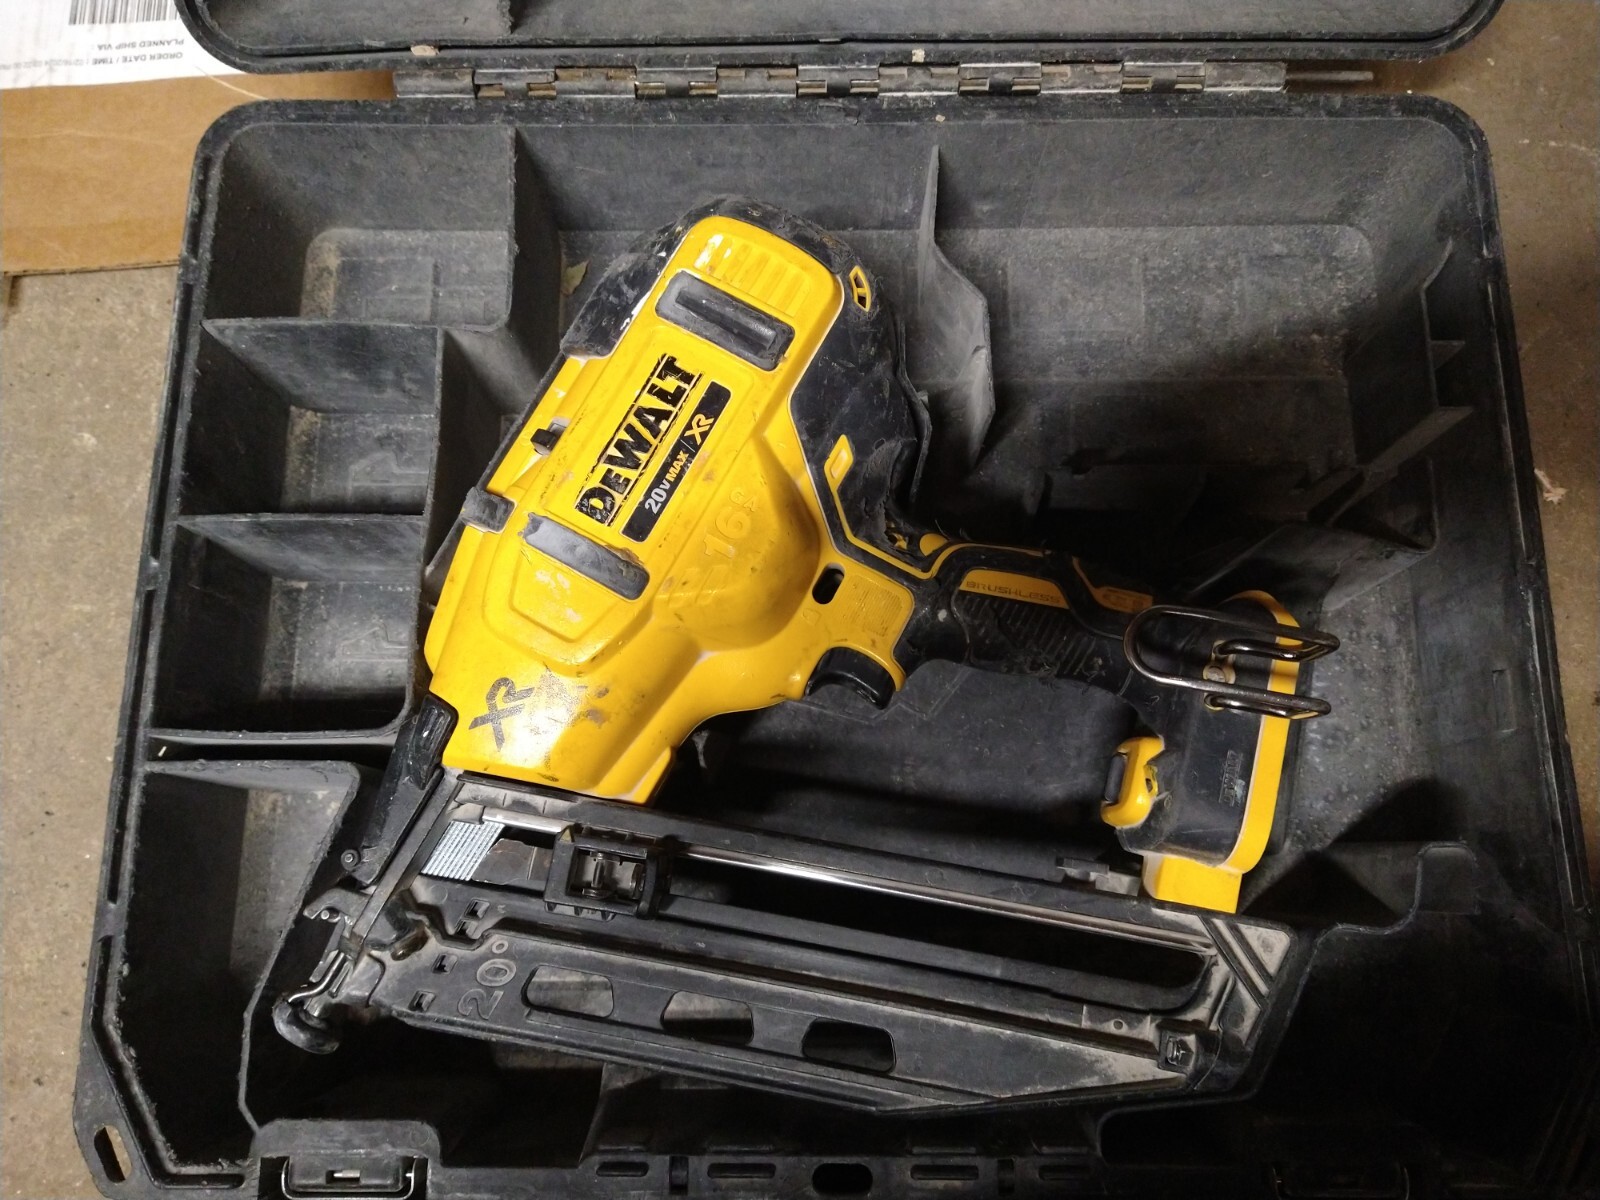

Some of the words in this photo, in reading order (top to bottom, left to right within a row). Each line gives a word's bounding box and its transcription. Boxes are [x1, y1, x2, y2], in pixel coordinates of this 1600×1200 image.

[115, 41, 137, 49] SHIP
[138, 38, 185, 48] PLANNED
[91, 56, 113, 65] TIME
[121, 54, 147, 63] DATE
[149, 51, 183, 61] ORDER
[575, 354, 700, 526] DEWALT
[668, 451, 690, 483] MAX
[684, 413, 714, 446] XR
[965, 580, 1061, 605] BRUSHLESS
